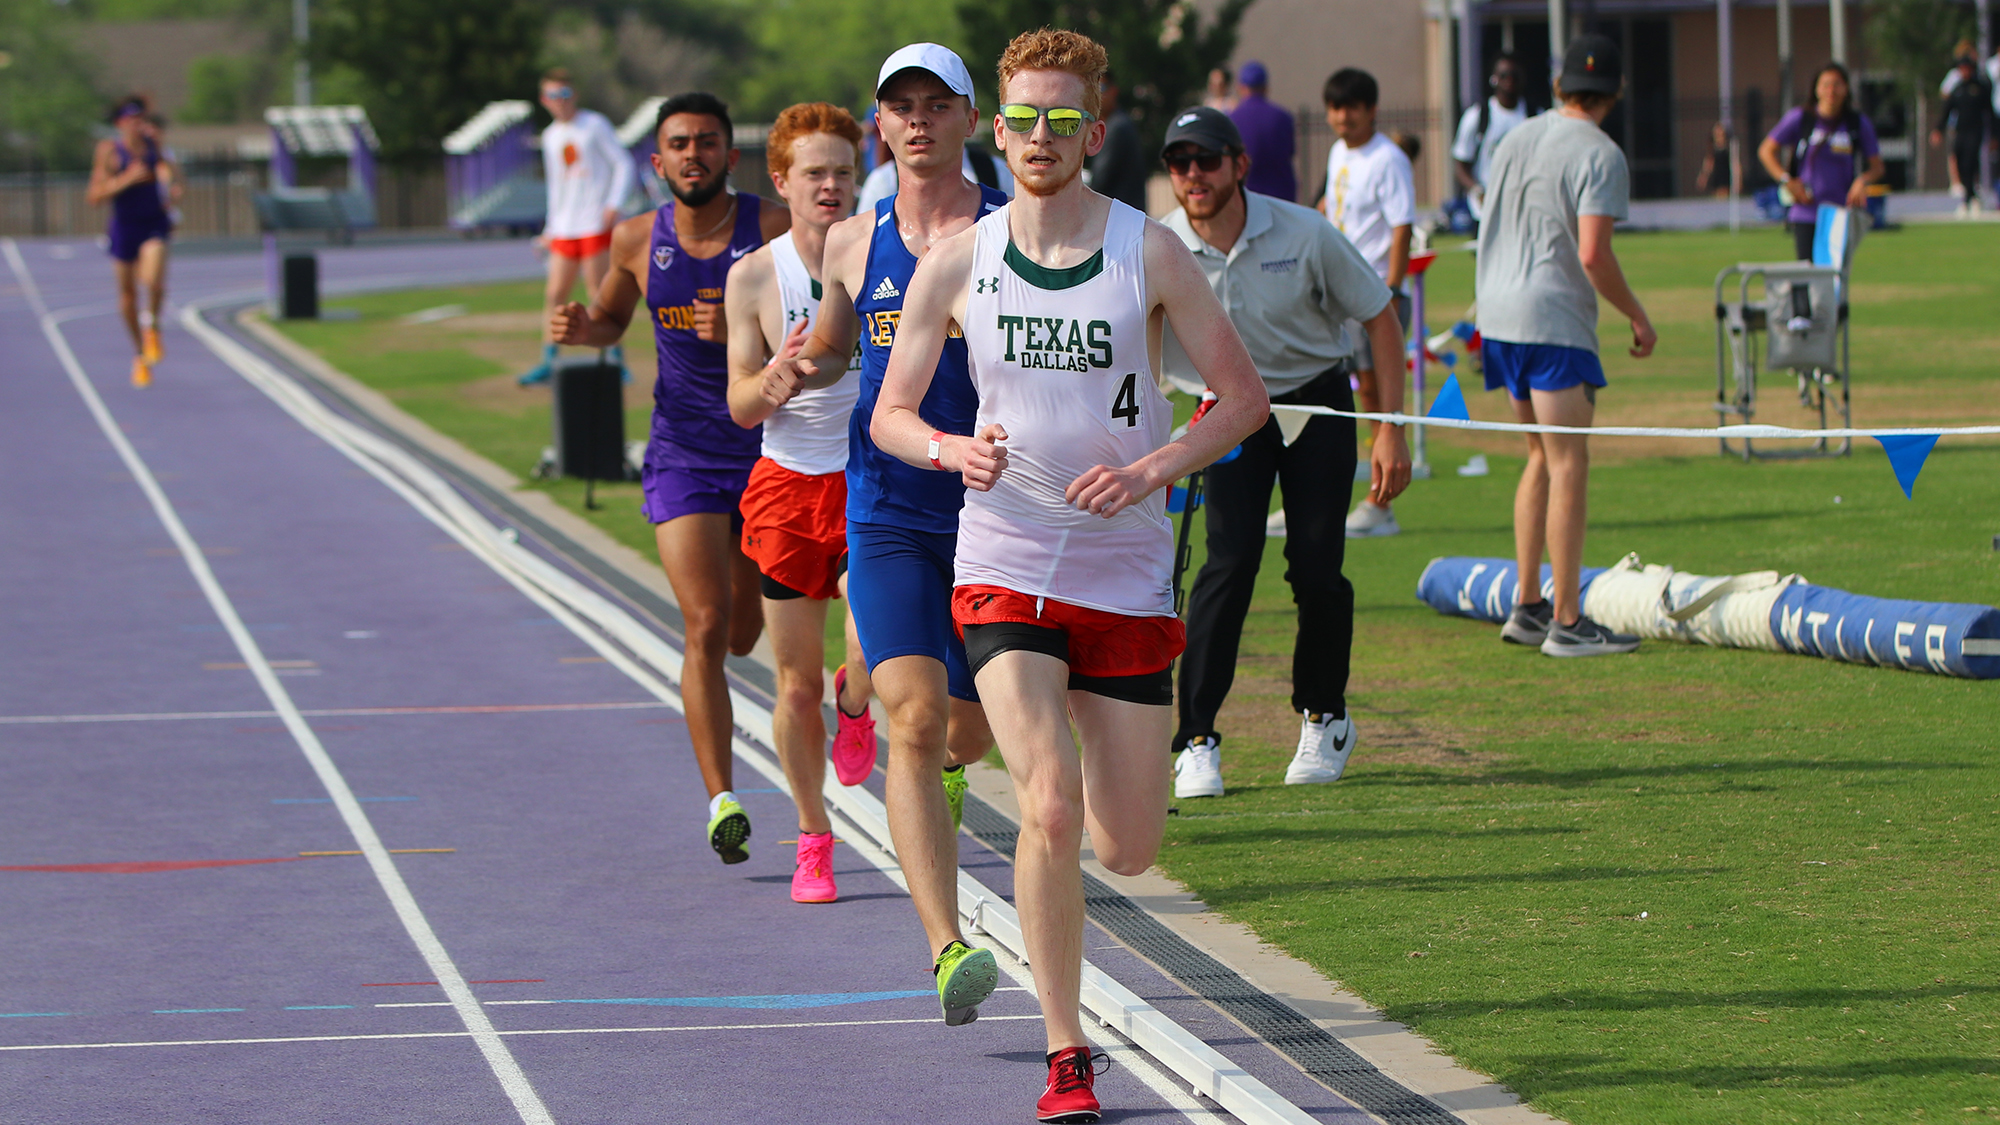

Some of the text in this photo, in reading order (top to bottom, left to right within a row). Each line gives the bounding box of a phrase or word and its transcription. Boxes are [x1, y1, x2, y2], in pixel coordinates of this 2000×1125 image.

[697, 287, 722, 298] TEXAS
[872, 289, 900, 300] adidas
[657, 305, 696, 330] CON
[866, 310, 901, 346] LET
[997, 314, 1113, 369] TEXAS
[1020, 352, 1088, 373] DALLAS
[1111, 372, 1139, 428] 4
